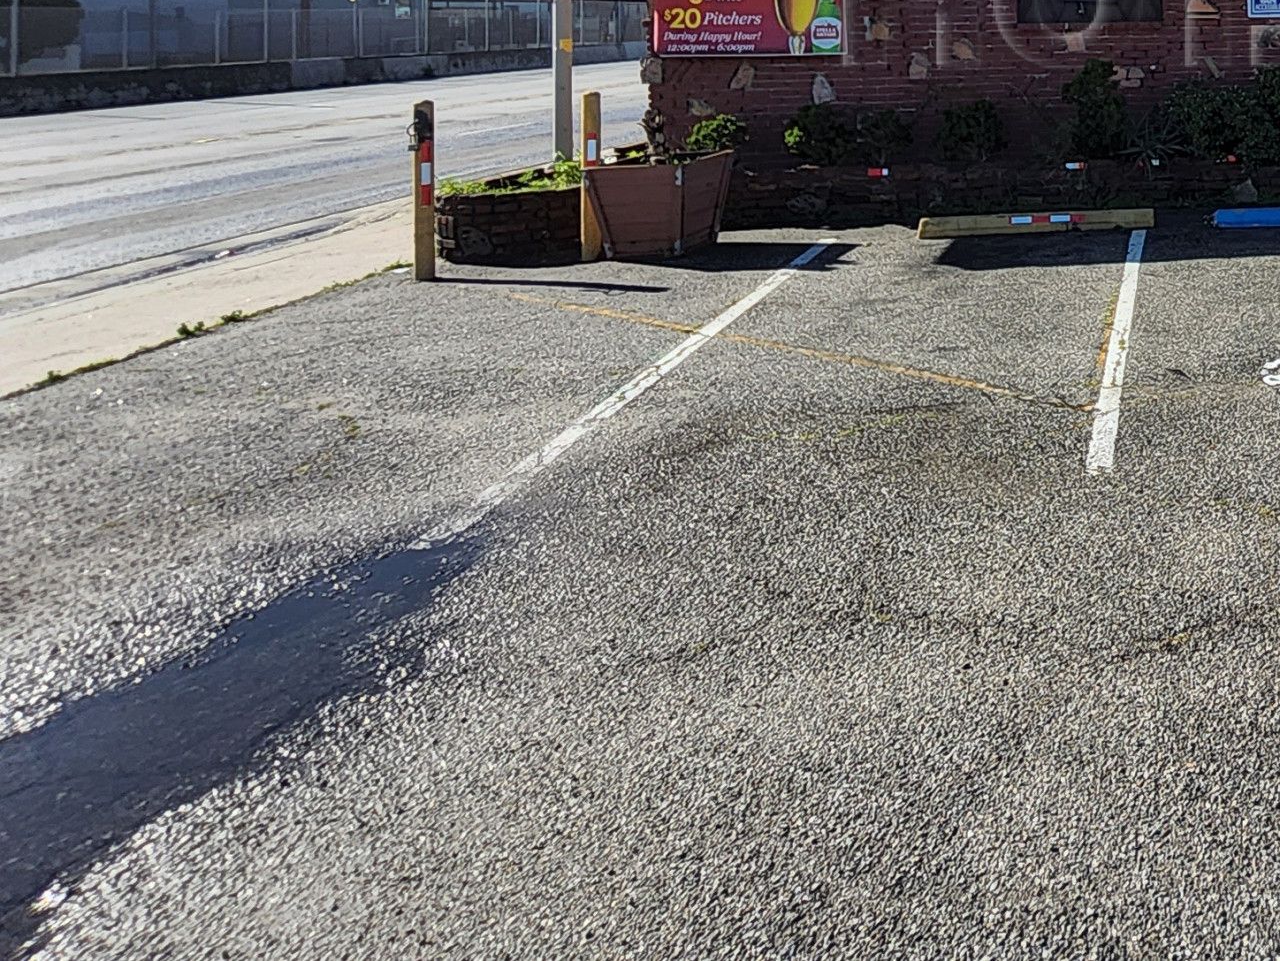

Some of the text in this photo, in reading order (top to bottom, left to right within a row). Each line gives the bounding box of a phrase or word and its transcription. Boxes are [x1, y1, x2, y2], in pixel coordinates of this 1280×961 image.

[663, 7, 762, 29] $20 Pitchers
[663, 31, 762, 43] During Happy Hour!
[667, 43, 708, 54] 12:00pm
[716, 43, 755, 54] 6:00pm
